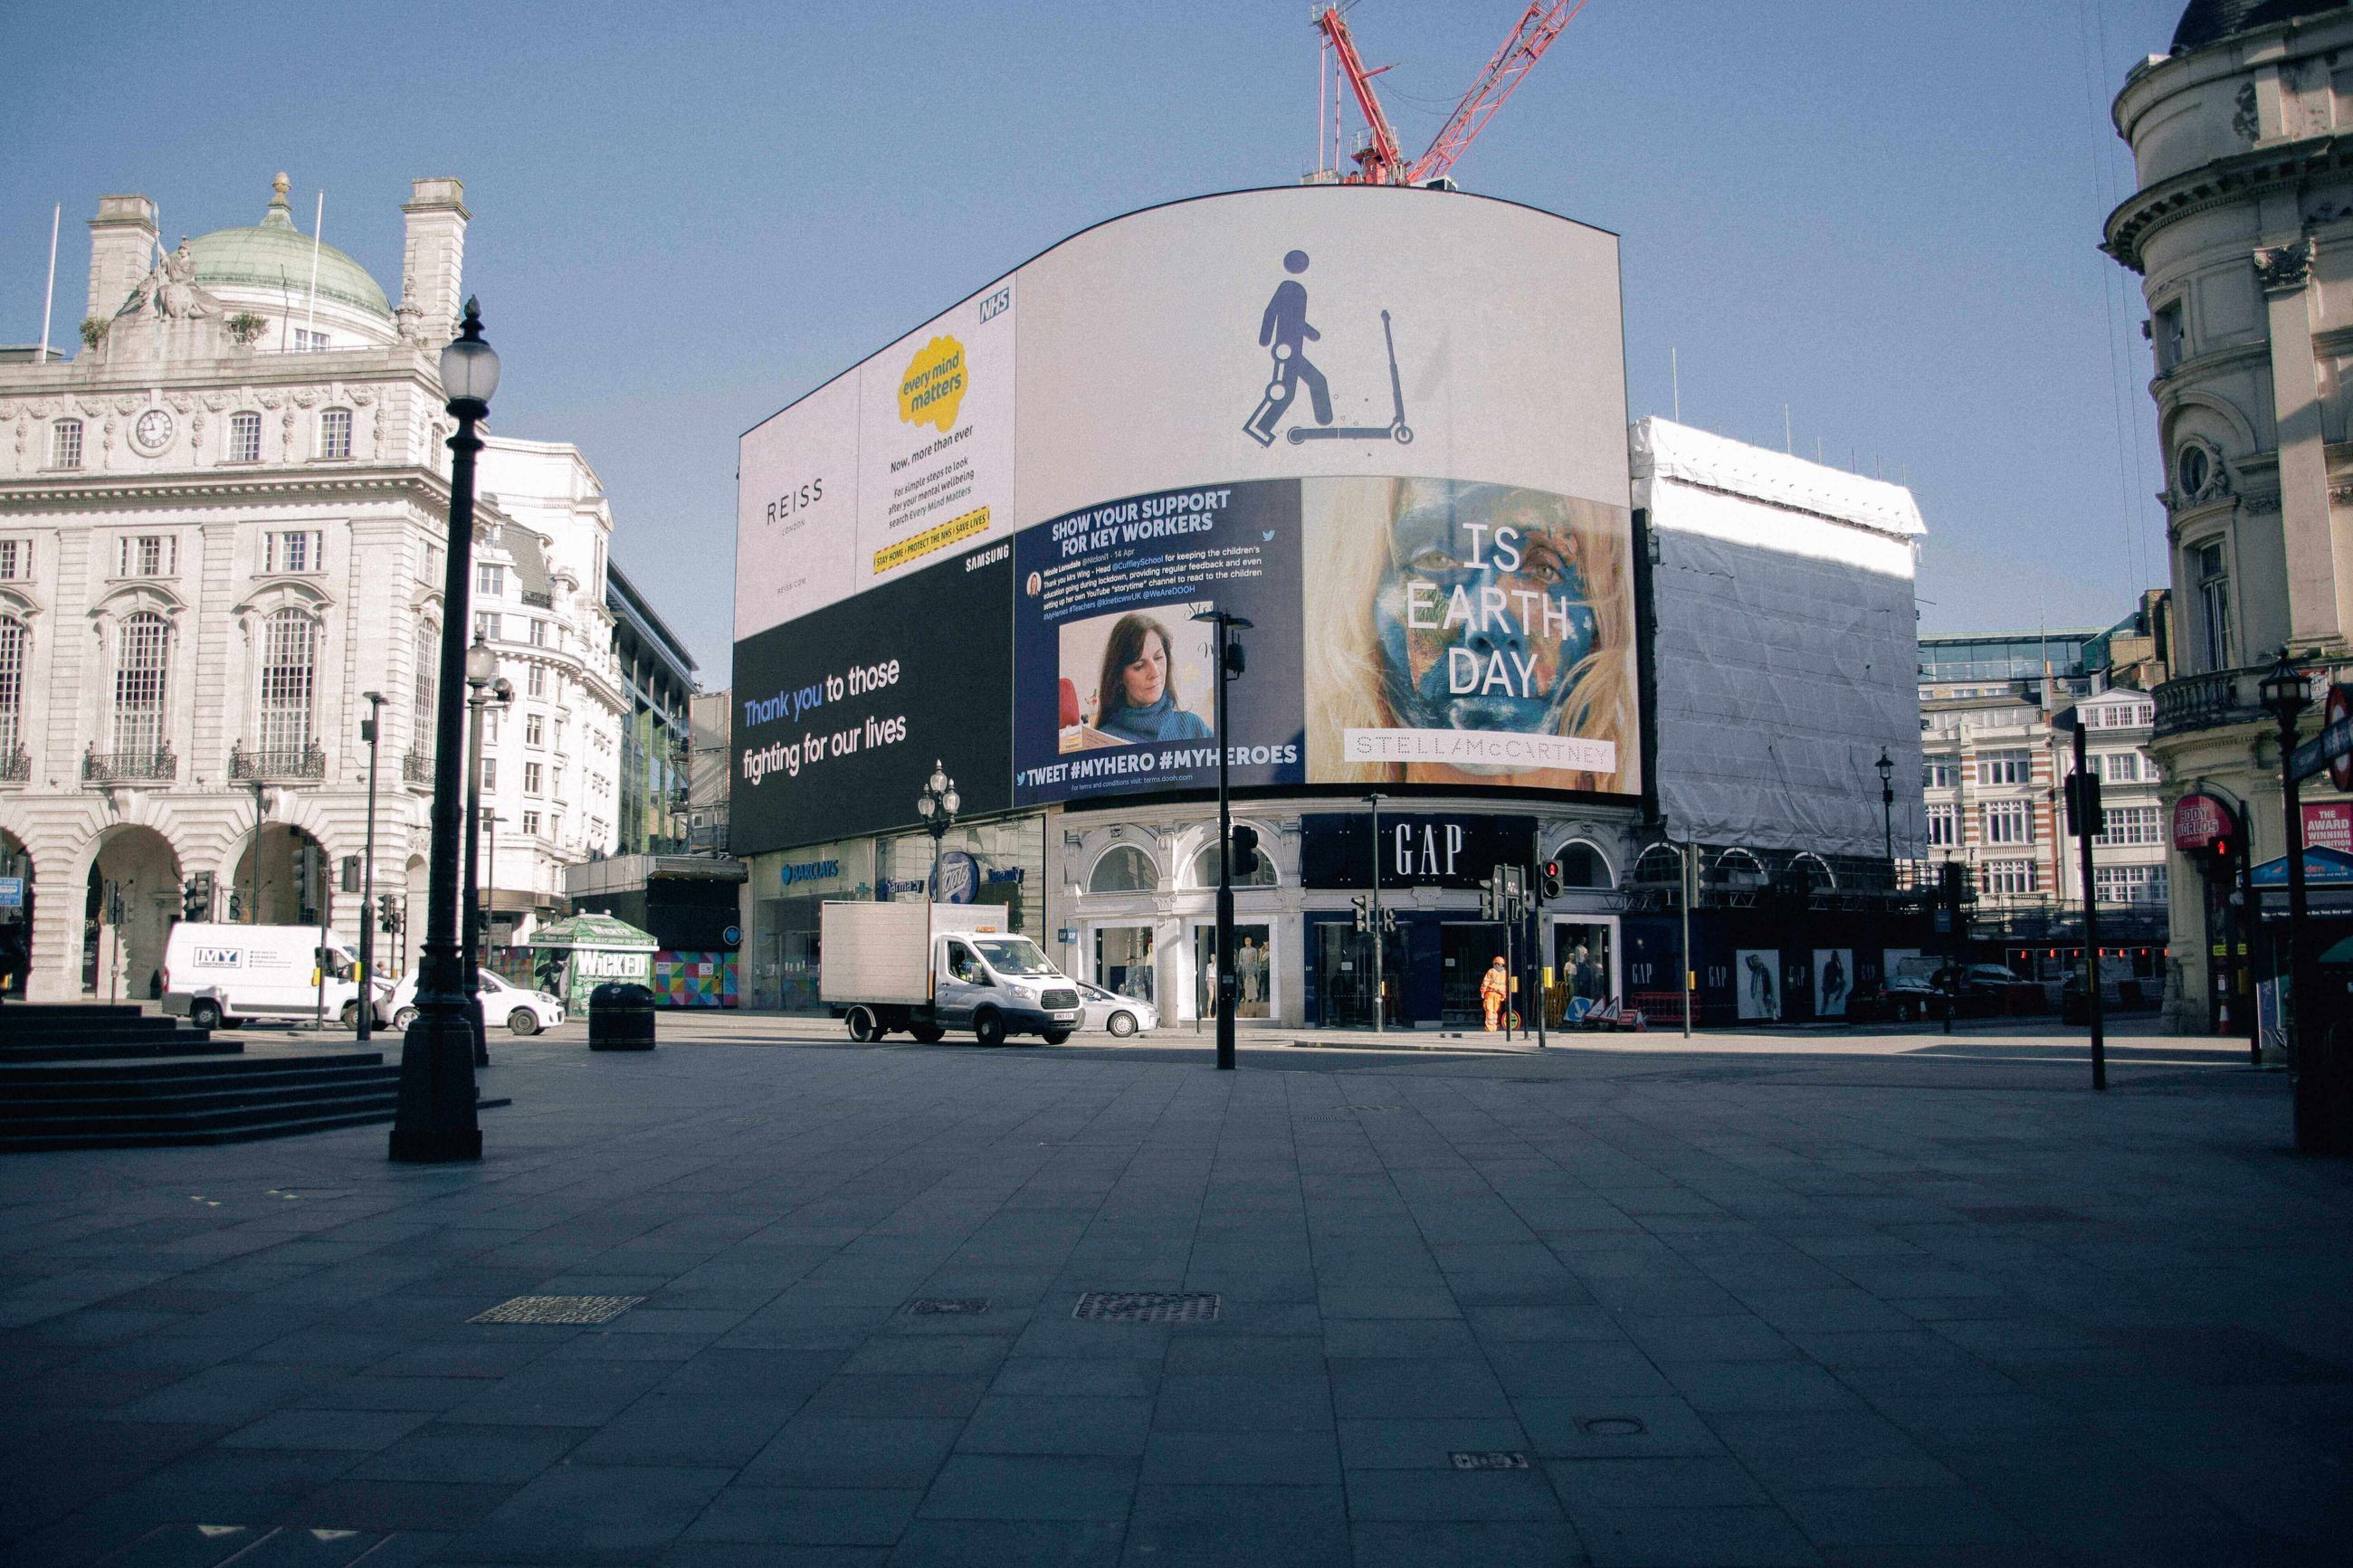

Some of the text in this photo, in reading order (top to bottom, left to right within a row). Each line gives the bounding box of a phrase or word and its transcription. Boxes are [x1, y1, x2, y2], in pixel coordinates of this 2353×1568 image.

[981, 288, 1009, 323] NHS
[903, 350, 959, 395] every mind
[911, 373, 961, 413] matters
[891, 425, 973, 474] Now, more than ever
[888, 470, 975, 516] after your mental wellbeing
[893, 455, 968, 499] For simple steps to look
[767, 478, 823, 526] REISS
[889, 486, 972, 529] search Every Mind Matters
[1053, 489, 1231, 542] SHOW YOUR SUPPORT
[782, 518, 805, 536] LONDON
[876, 514, 986, 566] STAY HOME PROTECT THE NHS SAVE LIVES
[1062, 512, 1213, 558] FOR KEY WORKERS
[1462, 522, 1521, 573] IS
[966, 544, 1010, 573] SAMSUNG
[1043, 580, 1057, 589] Thank
[1057, 576, 1066, 586] you
[1066, 573, 1076, 582] Mrs
[1077, 569, 1091, 579] Wing
[1095, 564, 1110, 574] Head
[1165, 554, 1176, 563] for
[1176, 550, 1205, 561] keeping
[1207, 548, 1221, 557] the
[1043, 558, 1262, 600] education going during lockdown, providing regular feedback and even
[1058, 560, 1081, 573] Lonsdale
[1114, 550, 1122, 559] 14
[1123, 548, 1135, 558] Apr
[1043, 600, 1059, 611] setting
[1058, 598, 1066, 609] up
[1065, 594, 1074, 603] her
[1074, 593, 1086, 601] own
[1086, 587, 1110, 598] YouTube
[1148, 575, 1176, 587] channel
[1177, 575, 1186, 584] to
[1186, 572, 1204, 582] read
[1205, 572, 1214, 580] to
[1215, 570, 1229, 579] the
[1230, 569, 1262, 578] children
[1069, 601, 1096, 613] #Teachers
[1142, 585, 1196, 600] @WeAreDOOH
[1406, 581, 1567, 641] EARTH
[744, 658, 900, 727] Thank you to those
[1448, 647, 1538, 698] DAY
[743, 715, 907, 786] fighting for our lives
[1026, 763, 1069, 787] TWEET
[1070, 752, 1156, 780] #MYHERO
[1071, 784, 1079, 792] For
[1079, 783, 1092, 791] terms
[1092, 781, 1102, 789] and
[1102, 778, 1129, 788] conditions
[2176, 819, 2219, 838] WORLDS
[2179, 805, 2208, 823] BODY
[2307, 819, 2349, 831] AWARD
[2319, 810, 2336, 819] THE
[1395, 822, 1463, 876] GAP
[2308, 830, 2350, 841] WINNING
[791, 860, 839, 882] BARCLAYS
[1632, 963, 1652, 984] GAP
[1709, 965, 1727, 987] GAP
